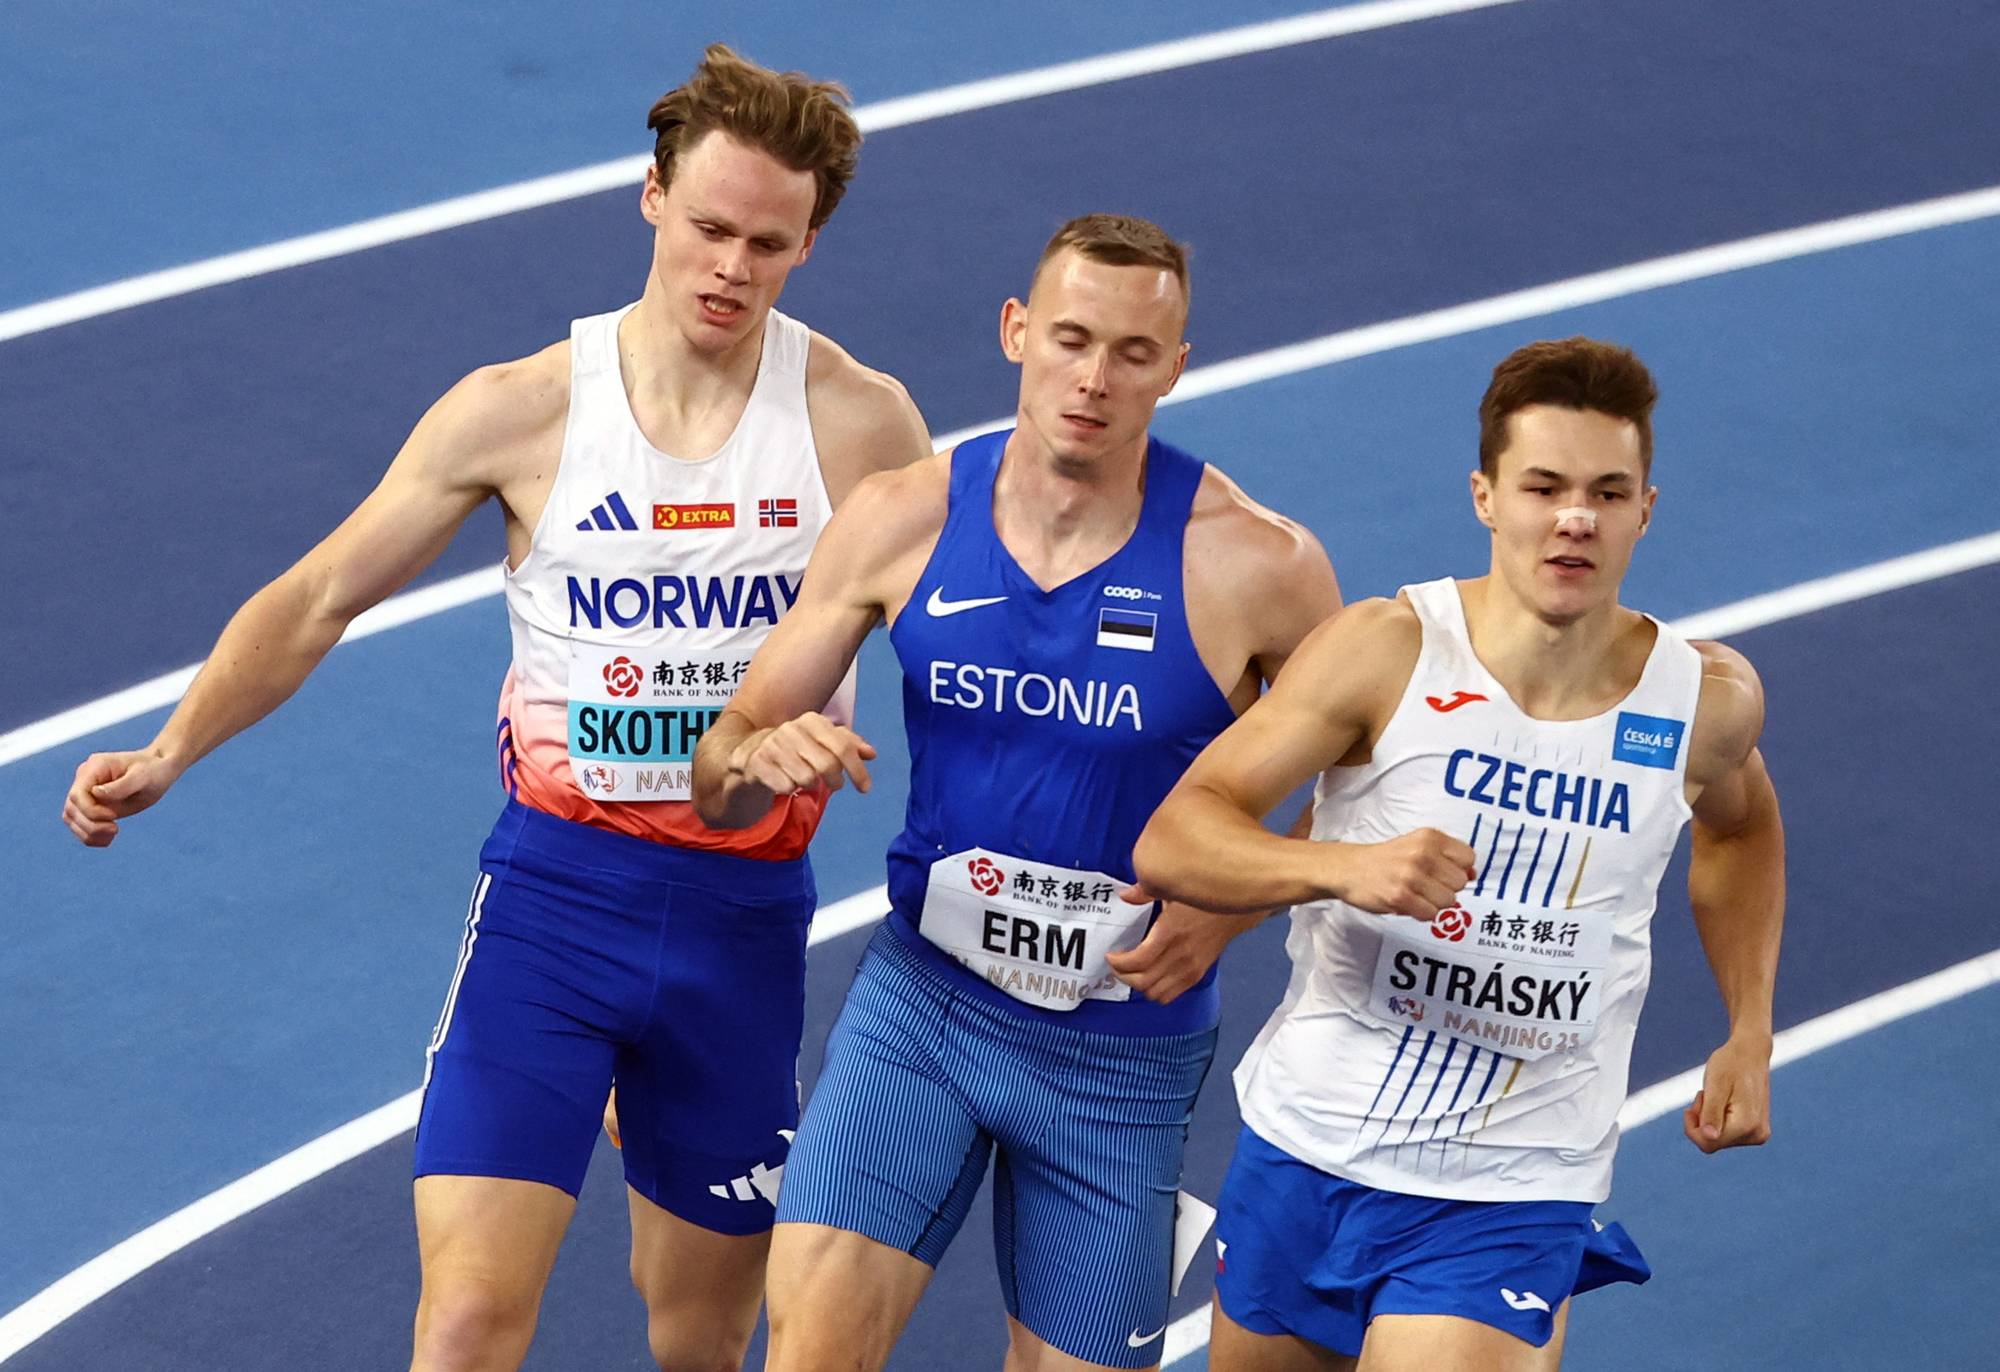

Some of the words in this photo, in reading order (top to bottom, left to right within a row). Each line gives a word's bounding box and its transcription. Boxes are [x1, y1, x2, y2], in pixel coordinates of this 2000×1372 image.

[682, 509, 731, 524] EXTRA
[1103, 585, 1143, 601] coop
[653, 688, 684, 697] BANK
[688, 688, 701, 697] OF
[930, 660, 1142, 732] ESTONIA
[1444, 748, 1631, 834] CZECHIA
[1012, 869, 1114, 904] 南京银行
[1012, 893, 1043, 905] BANK
[1046, 900, 1059, 909] OF
[1063, 903, 1111, 915] NANJING
[981, 909, 1087, 971] ERM
[1480, 909, 1580, 947] 南京银行
[1477, 938, 1508, 950] BANK
[1512, 943, 1526, 953] OF
[1529, 946, 1575, 958] NANJING
[1389, 949, 1592, 1021] STRÁSKÝ
[1443, 1010, 1553, 1051] NANJING
[1554, 1031, 1580, 1052] 25
